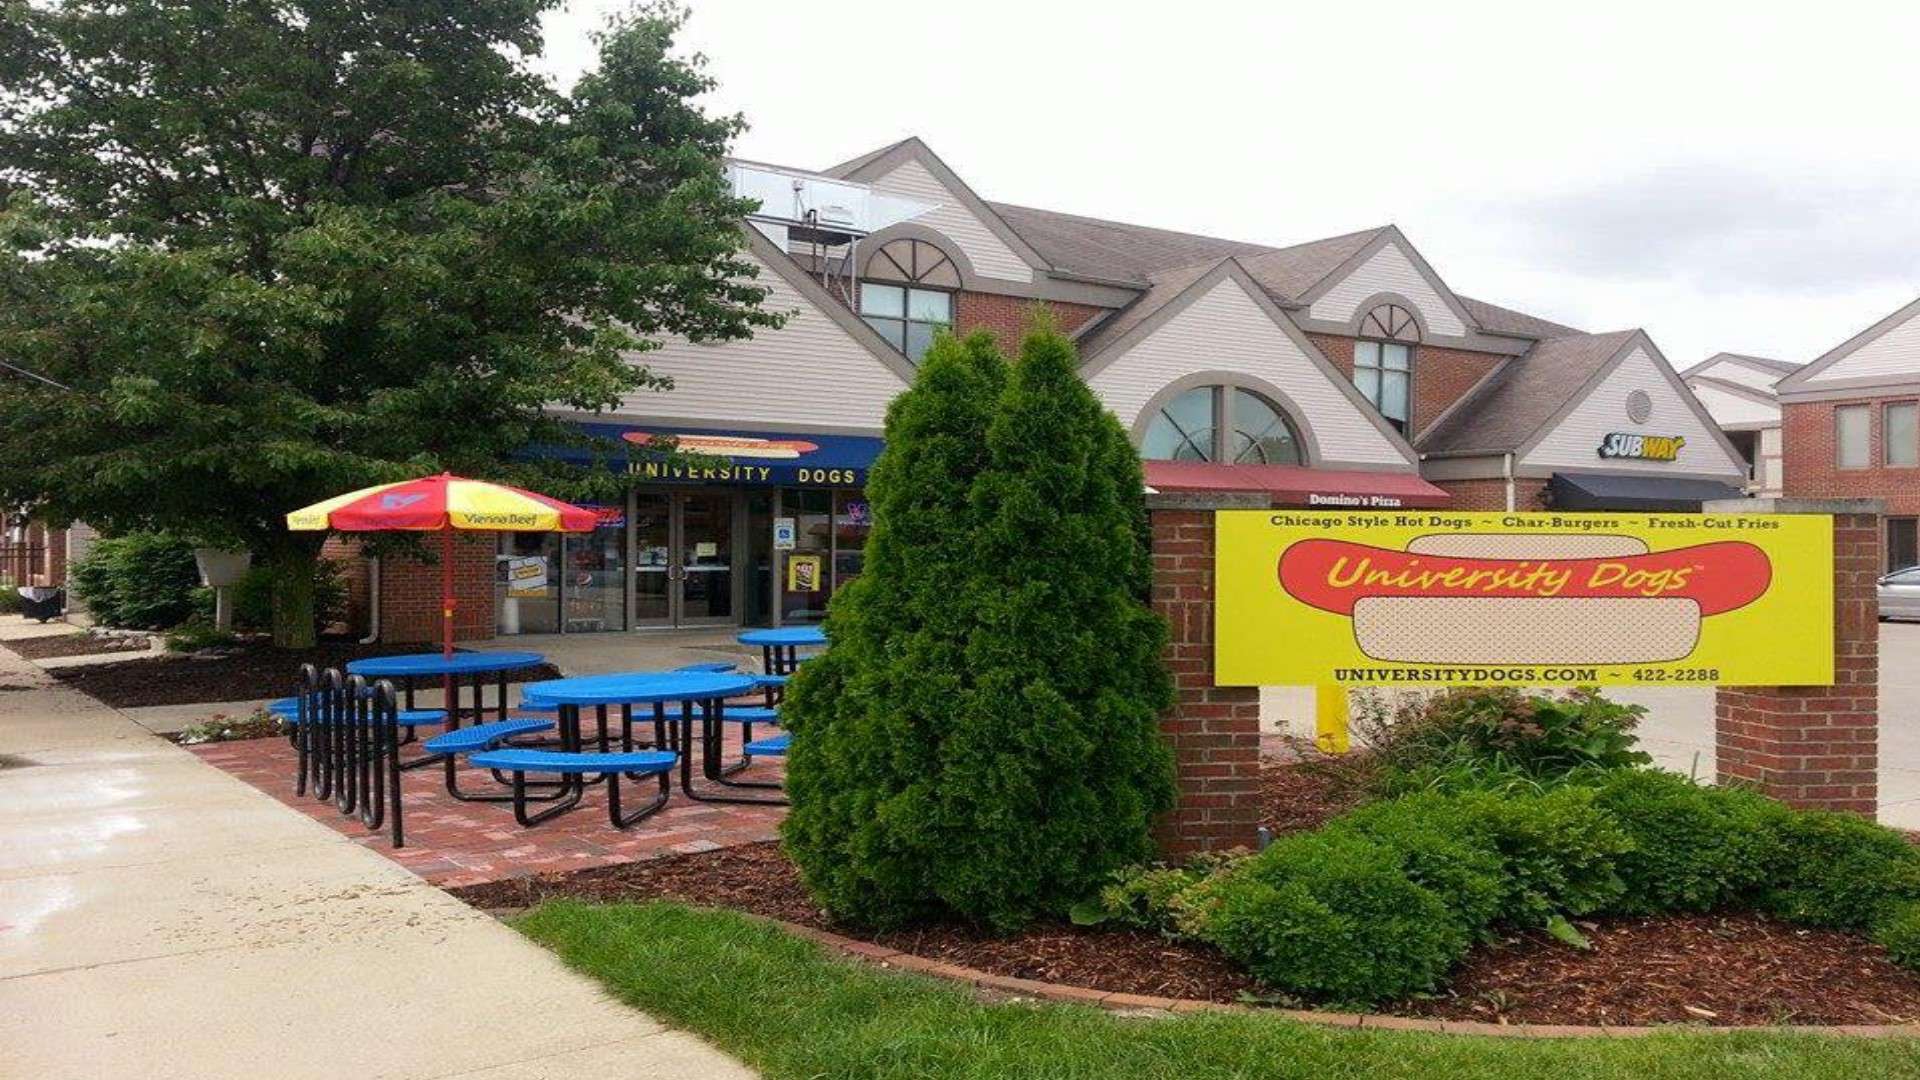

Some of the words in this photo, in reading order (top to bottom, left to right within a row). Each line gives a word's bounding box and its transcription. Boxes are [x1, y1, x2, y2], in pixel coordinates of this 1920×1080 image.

[1603, 434, 1685, 460] SUBWAY
[799, 468, 855, 484] DOGS
[1309, 493, 1369, 505] Domino's
[1371, 496, 1401, 507] Pizza
[464, 513, 507, 525] Vienna
[509, 513, 537, 526] Beef
[1270, 515, 1343, 528] Chicago
[1347, 515, 1390, 528] Style
[1394, 516, 1425, 527] Hot
[1429, 516, 1473, 528] Dogs
[1502, 517, 1619, 529] Char-Burgers
[1648, 517, 1732, 530] Fresh-Cut
[1737, 517, 1780, 530] Fries
[1327, 557, 1572, 596] University
[1588, 561, 1695, 597] Dogs
[1334, 668, 1598, 683] UNIVERSITYDOGS.COM
[1632, 669, 1721, 682] 422-2288
